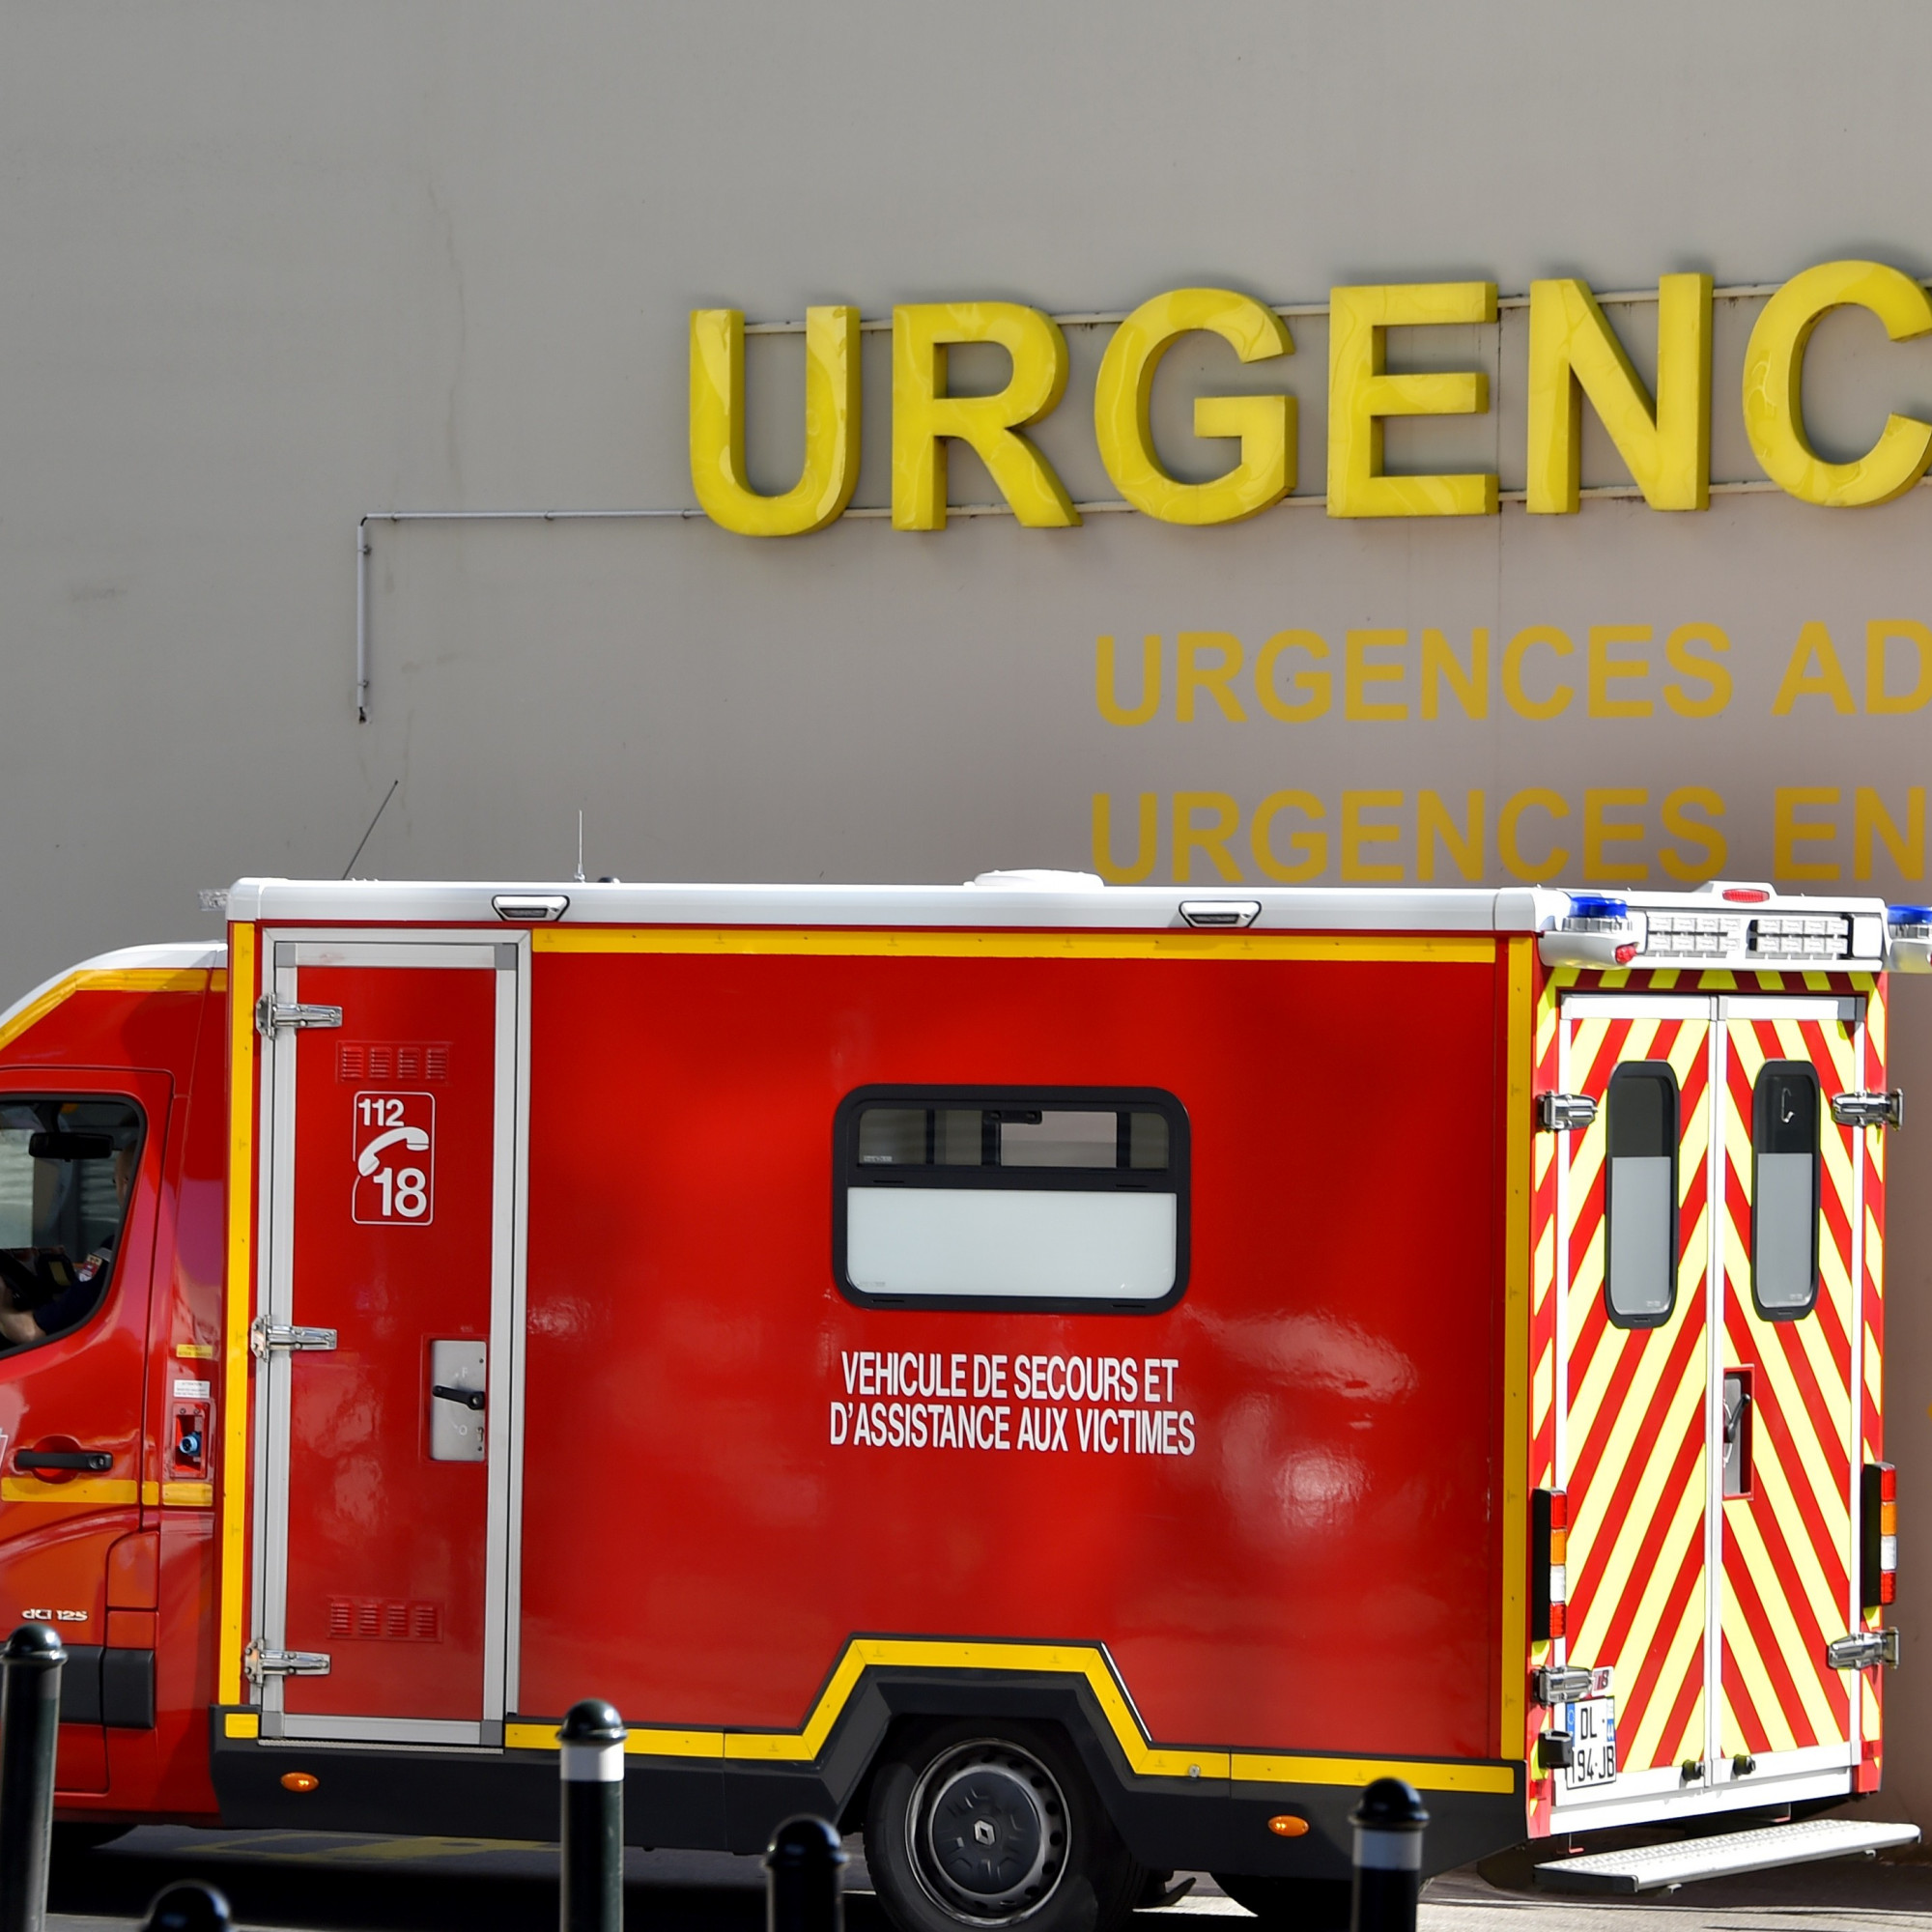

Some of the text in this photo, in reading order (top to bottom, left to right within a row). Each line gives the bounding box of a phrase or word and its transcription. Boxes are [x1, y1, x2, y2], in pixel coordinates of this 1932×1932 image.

[689, 260, 1932, 537] URGENC
[1095, 619, 1932, 726] URGENCES AD
[1092, 785, 1926, 884] URGENCES EN
[357, 1097, 405, 1127] 112
[373, 1167, 428, 1218] 18
[840, 1350, 1179, 1404] VEHICULE DE SECOURS ET
[830, 1401, 1196, 1457] D'ASSISTANCE AUX VICTIMES
[56, 1609, 88, 1622] 125
